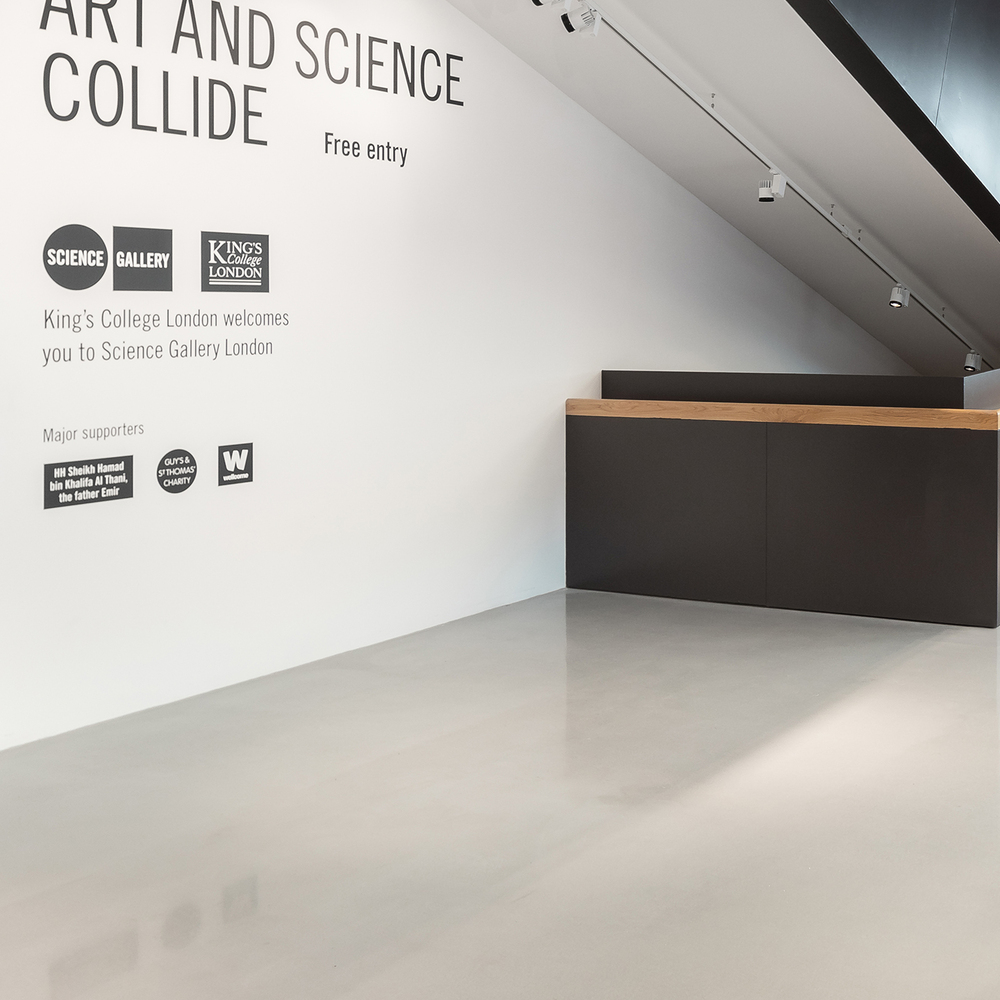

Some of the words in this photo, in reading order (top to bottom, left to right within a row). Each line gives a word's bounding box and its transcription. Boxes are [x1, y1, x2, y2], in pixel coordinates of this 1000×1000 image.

[295, 20, 464, 107] SCIENCE
[42, 52, 268, 146] COLLIDE
[324, 132, 361, 159] Free
[366, 140, 408, 168] entry
[47, 248, 105, 267] SCIENCE
[116, 251, 170, 269] GALLERY
[208, 239, 263, 264] KING'S
[226, 253, 262, 266] College
[208, 266, 262, 279] LONDON
[44, 309, 94, 333] King's
[101, 308, 161, 332] College
[166, 309, 218, 328] London
[223, 308, 289, 327] welcomes
[42, 346, 72, 368] you
[78, 342, 95, 362] to
[101, 340, 163, 361] Science
[169, 339, 220, 361] Gallery
[225, 338, 273, 357] London
[43, 427, 78, 444] Major
[82, 423, 145, 441] supporters
[54, 467, 66, 478] HH
[68, 464, 95, 477] Sheikh
[97, 461, 124, 473] Hamad
[164, 456, 184, 466] GUY'S
[184, 455, 190, 464] &
[223, 449, 249, 472] W
[50, 481, 63, 491] bin
[65, 477, 93, 489] Khalifa
[95, 475, 103, 486] Al
[104, 473, 128, 484] Thani,
[163, 477, 191, 487] CHARITY
[223, 473, 249, 481] wellcome
[58, 492, 73, 503] the
[74, 490, 100, 501] father
[101, 486, 120, 498] Emir
